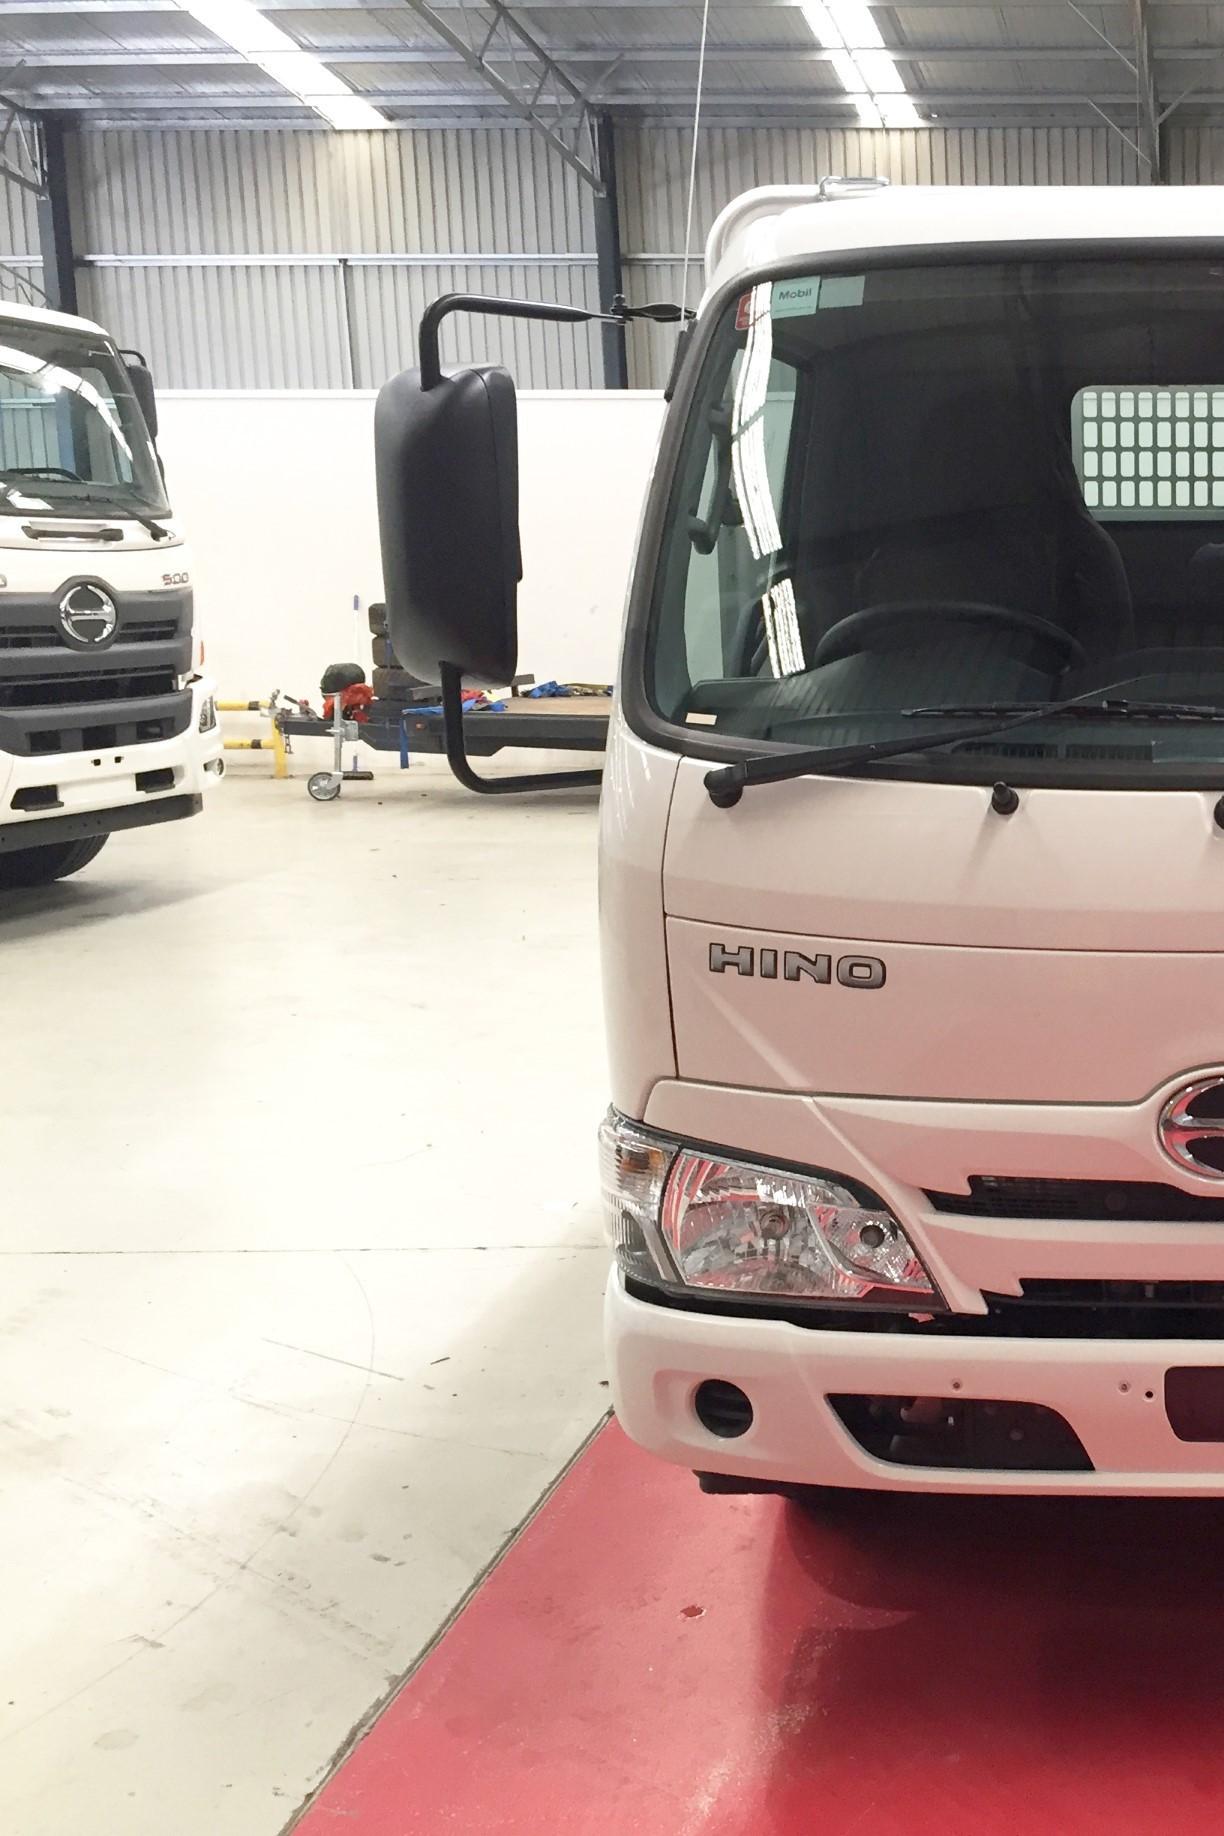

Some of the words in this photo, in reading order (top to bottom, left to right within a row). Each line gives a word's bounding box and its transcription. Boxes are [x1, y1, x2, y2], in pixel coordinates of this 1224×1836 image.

[778, 288, 812, 300] Mobil
[162, 572, 189, 586] 500
[708, 942, 887, 989] HINO
